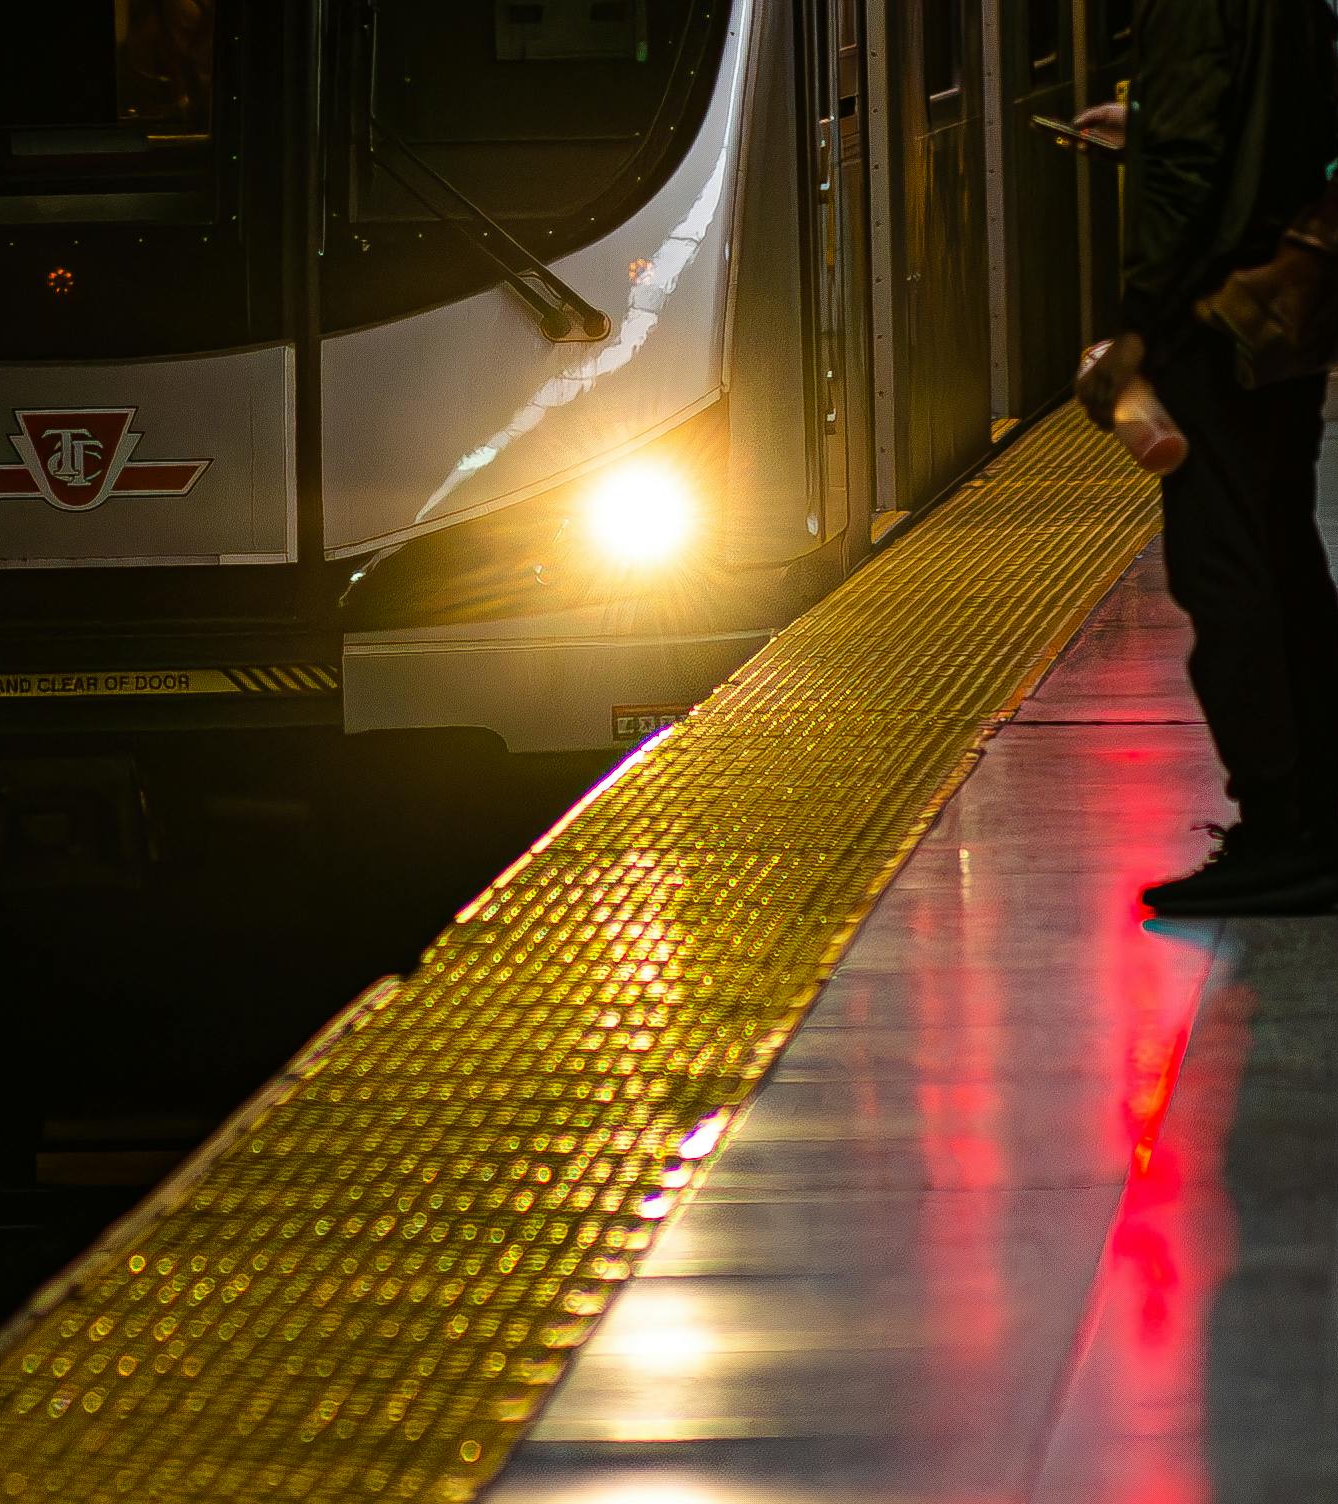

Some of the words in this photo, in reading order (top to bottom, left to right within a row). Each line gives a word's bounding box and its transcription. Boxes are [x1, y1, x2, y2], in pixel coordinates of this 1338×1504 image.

[37, 677, 98, 693] CLEAR
[104, 675, 129, 691] OF
[134, 674, 190, 691] DOOR
